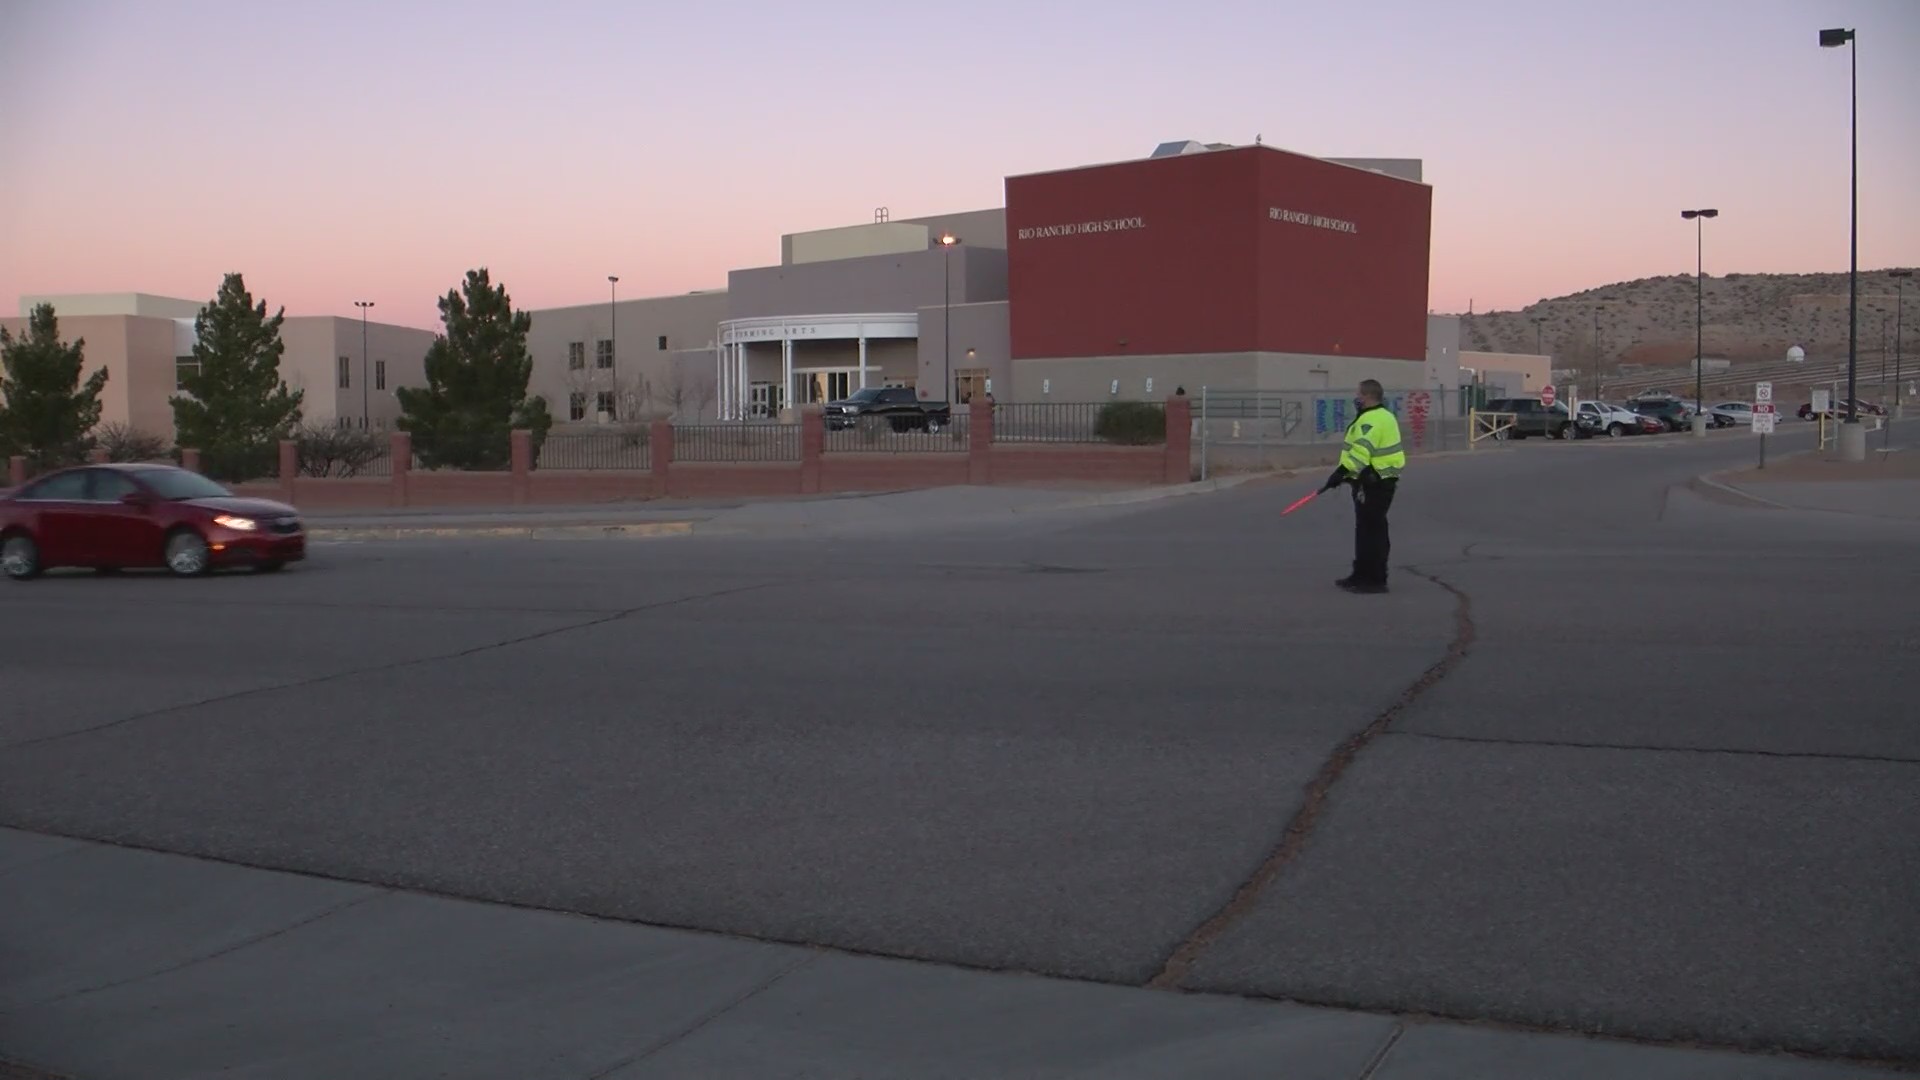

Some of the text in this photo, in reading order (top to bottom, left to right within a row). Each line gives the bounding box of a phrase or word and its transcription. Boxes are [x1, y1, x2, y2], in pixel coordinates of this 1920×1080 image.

[1018, 216, 1145, 240] RIO RANCHO HIGH SCHOOL
[1269, 207, 1357, 234] RIO RANCHO HIGH SCHOOL
[784, 326, 816, 336] ARTS
[1757, 405, 1769, 413] NO
